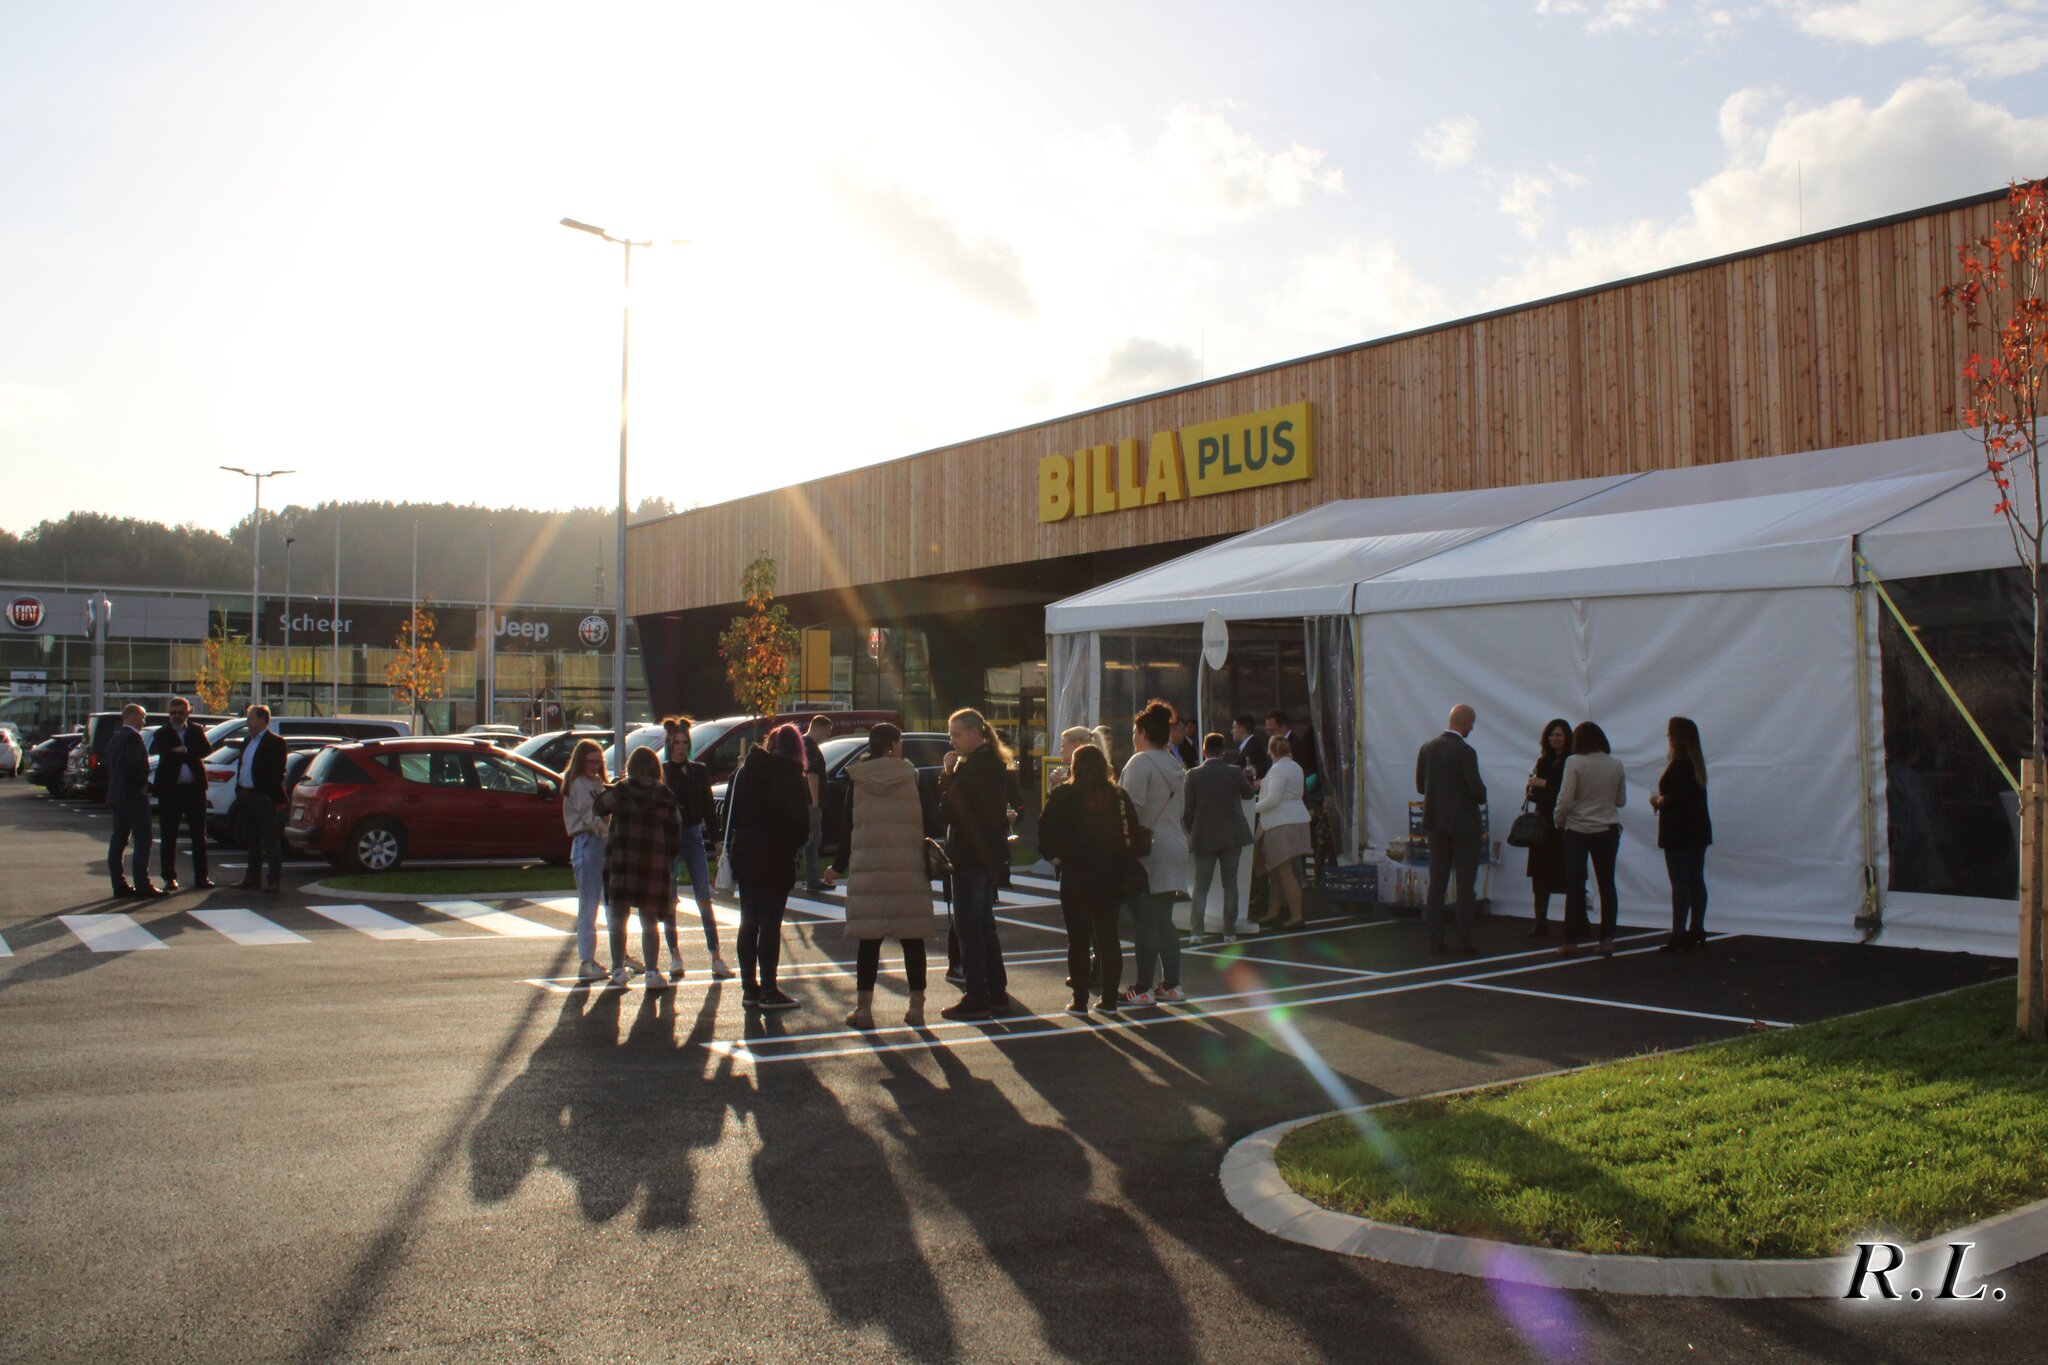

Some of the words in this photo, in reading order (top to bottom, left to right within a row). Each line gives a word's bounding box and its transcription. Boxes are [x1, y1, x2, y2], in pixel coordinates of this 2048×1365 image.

[1039, 431, 1184, 523] BILLA
[1198, 420, 1295, 480] PLUS
[15, 605, 38, 621] FIAT
[280, 613, 353, 633] Scheer
[494, 616, 548, 641] Jeep
